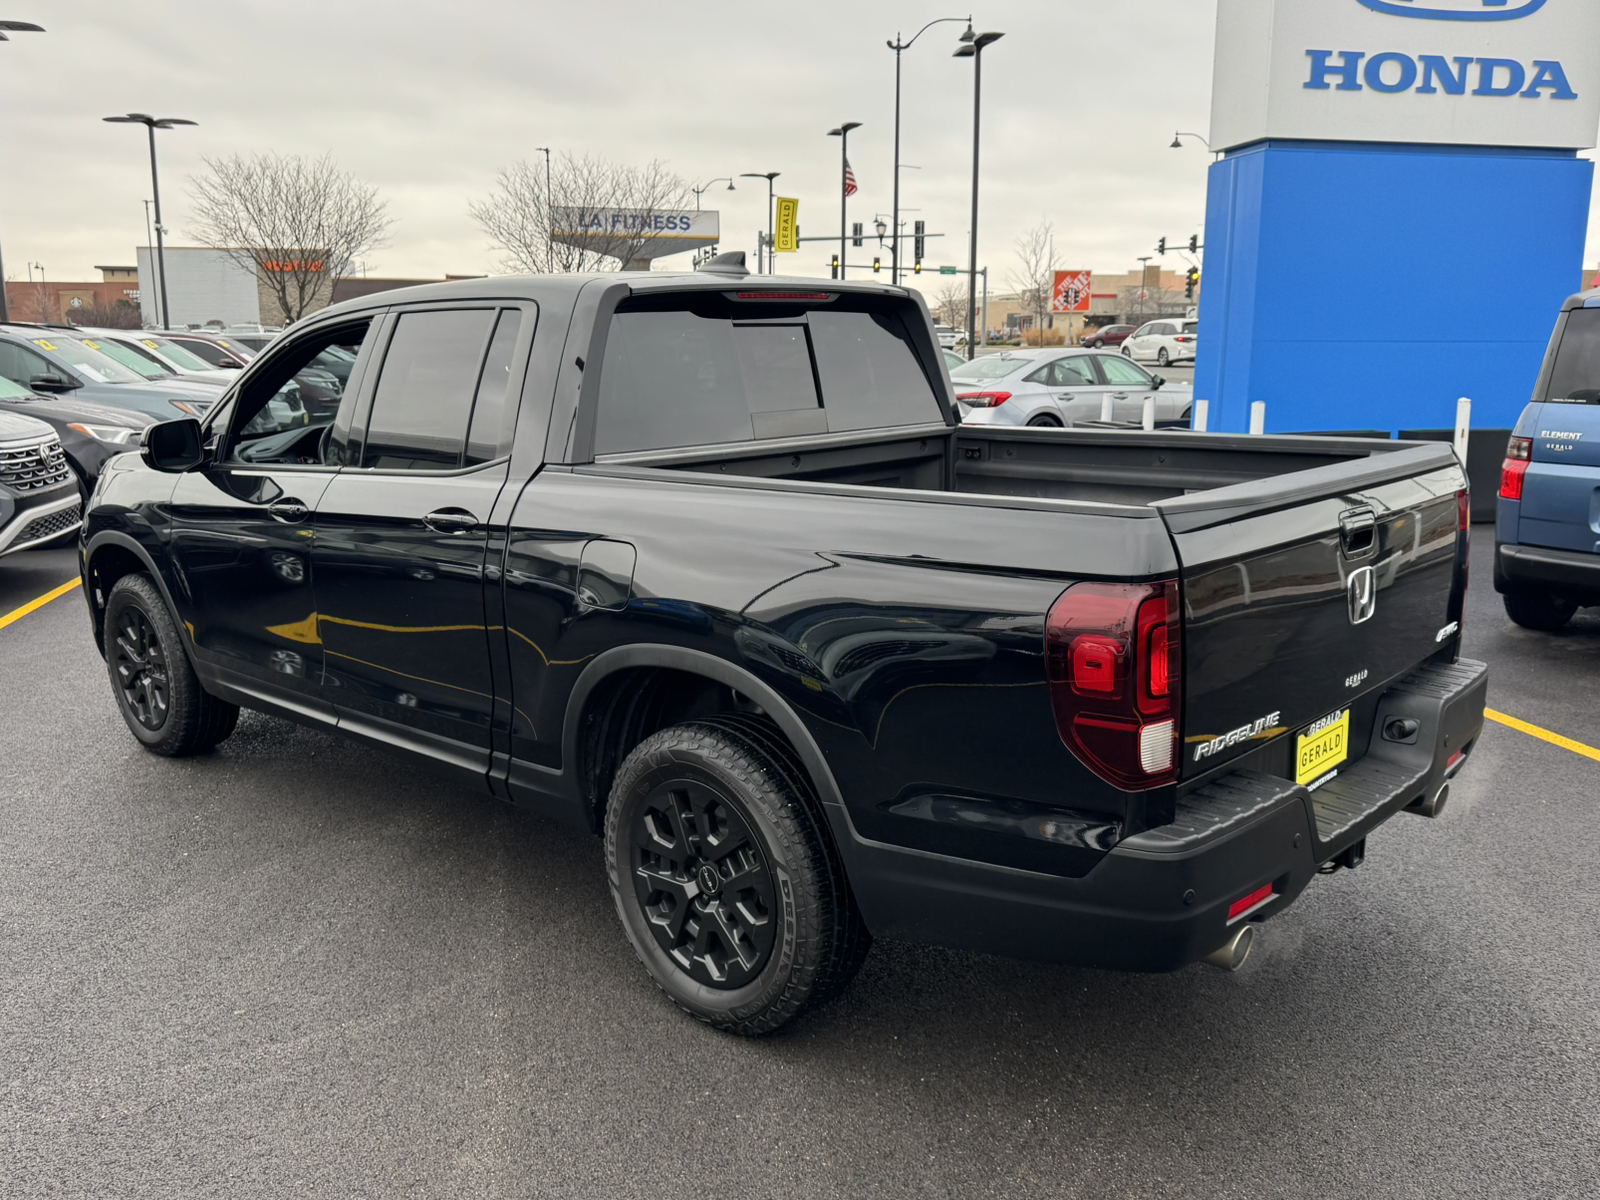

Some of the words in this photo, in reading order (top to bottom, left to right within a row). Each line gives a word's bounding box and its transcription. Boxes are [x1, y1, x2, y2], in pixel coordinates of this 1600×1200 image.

[1303, 49, 1578, 100] HONDA
[578, 213, 603, 229] LA
[611, 214, 691, 231] FITNESS
[782, 204, 791, 246] GERALD
[1541, 430, 1583, 441] ELEMENT
[1545, 443, 1573, 451] GERALD
[1345, 669, 1368, 687] GERALD
[1308, 710, 1342, 735] GERALD
[1193, 711, 1281, 762] RIDGELINE
[1301, 733, 1341, 767] GERALD
